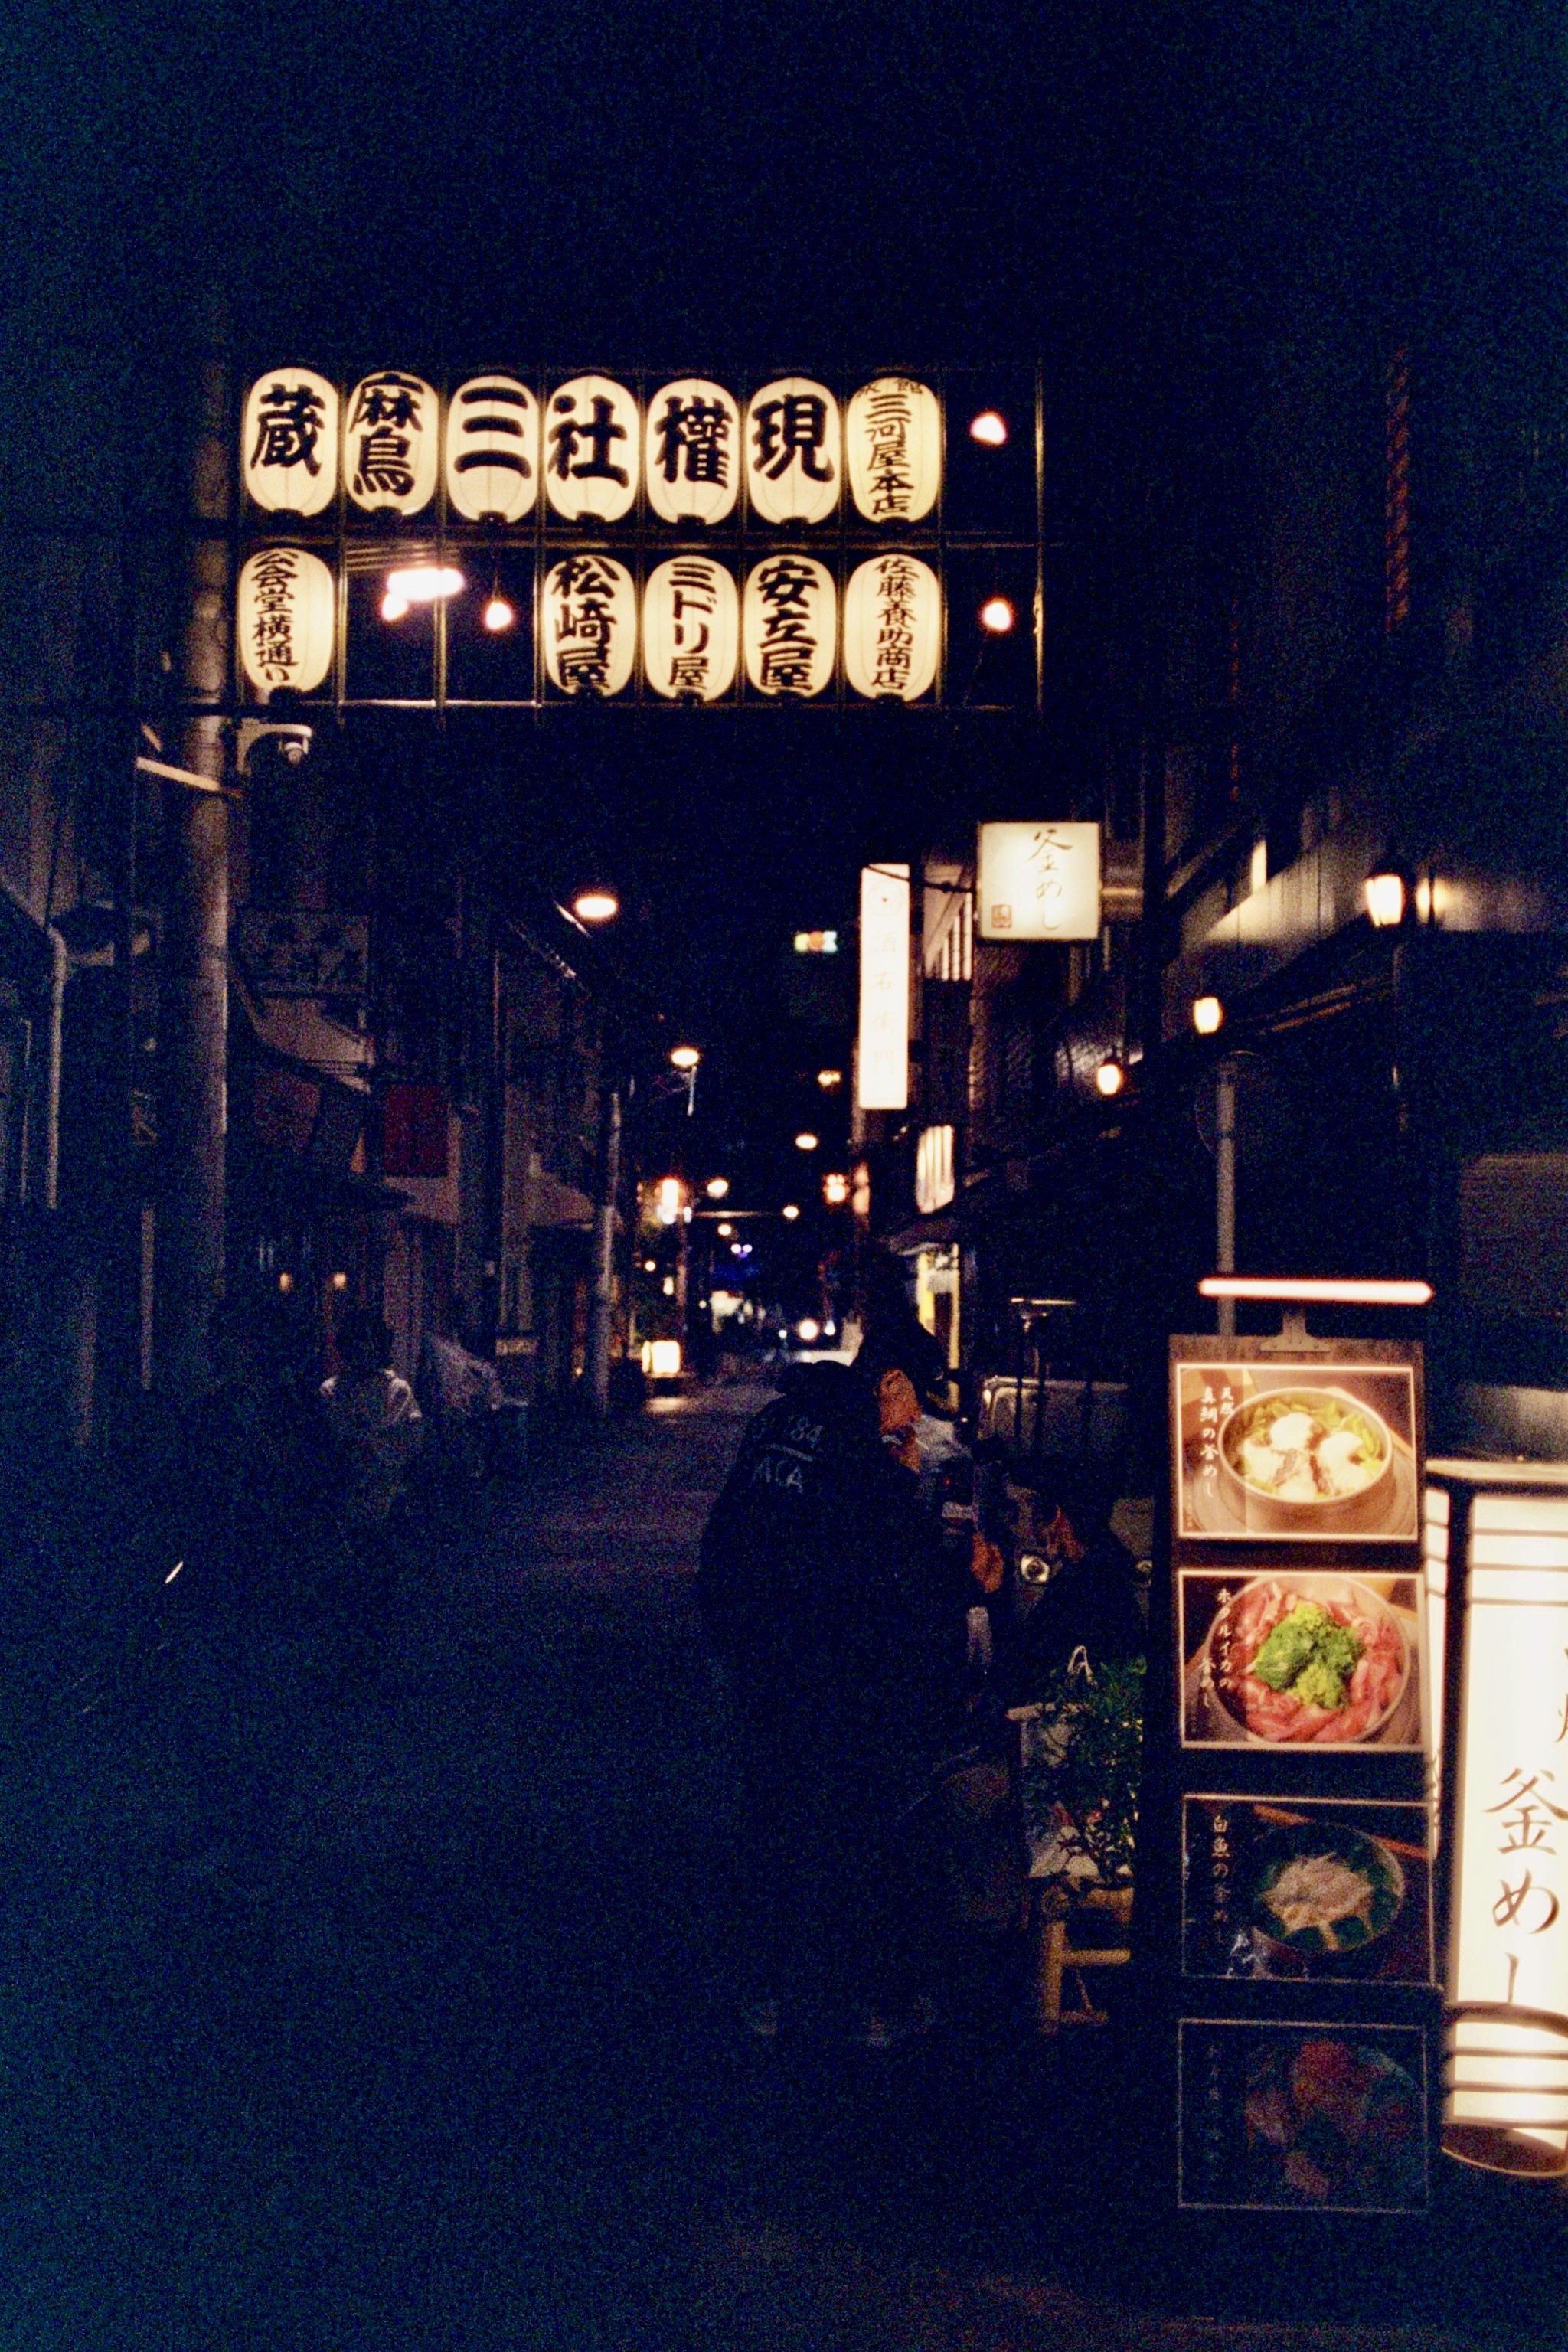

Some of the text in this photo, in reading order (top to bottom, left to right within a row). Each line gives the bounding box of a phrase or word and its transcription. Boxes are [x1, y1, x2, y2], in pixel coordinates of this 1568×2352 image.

[250, 384, 325, 476] 蔵
[864, 394, 913, 515] 三河屋本店
[668, 563, 717, 689] ミドリ屋
[871, 558, 920, 690] 佐藤養助商店
